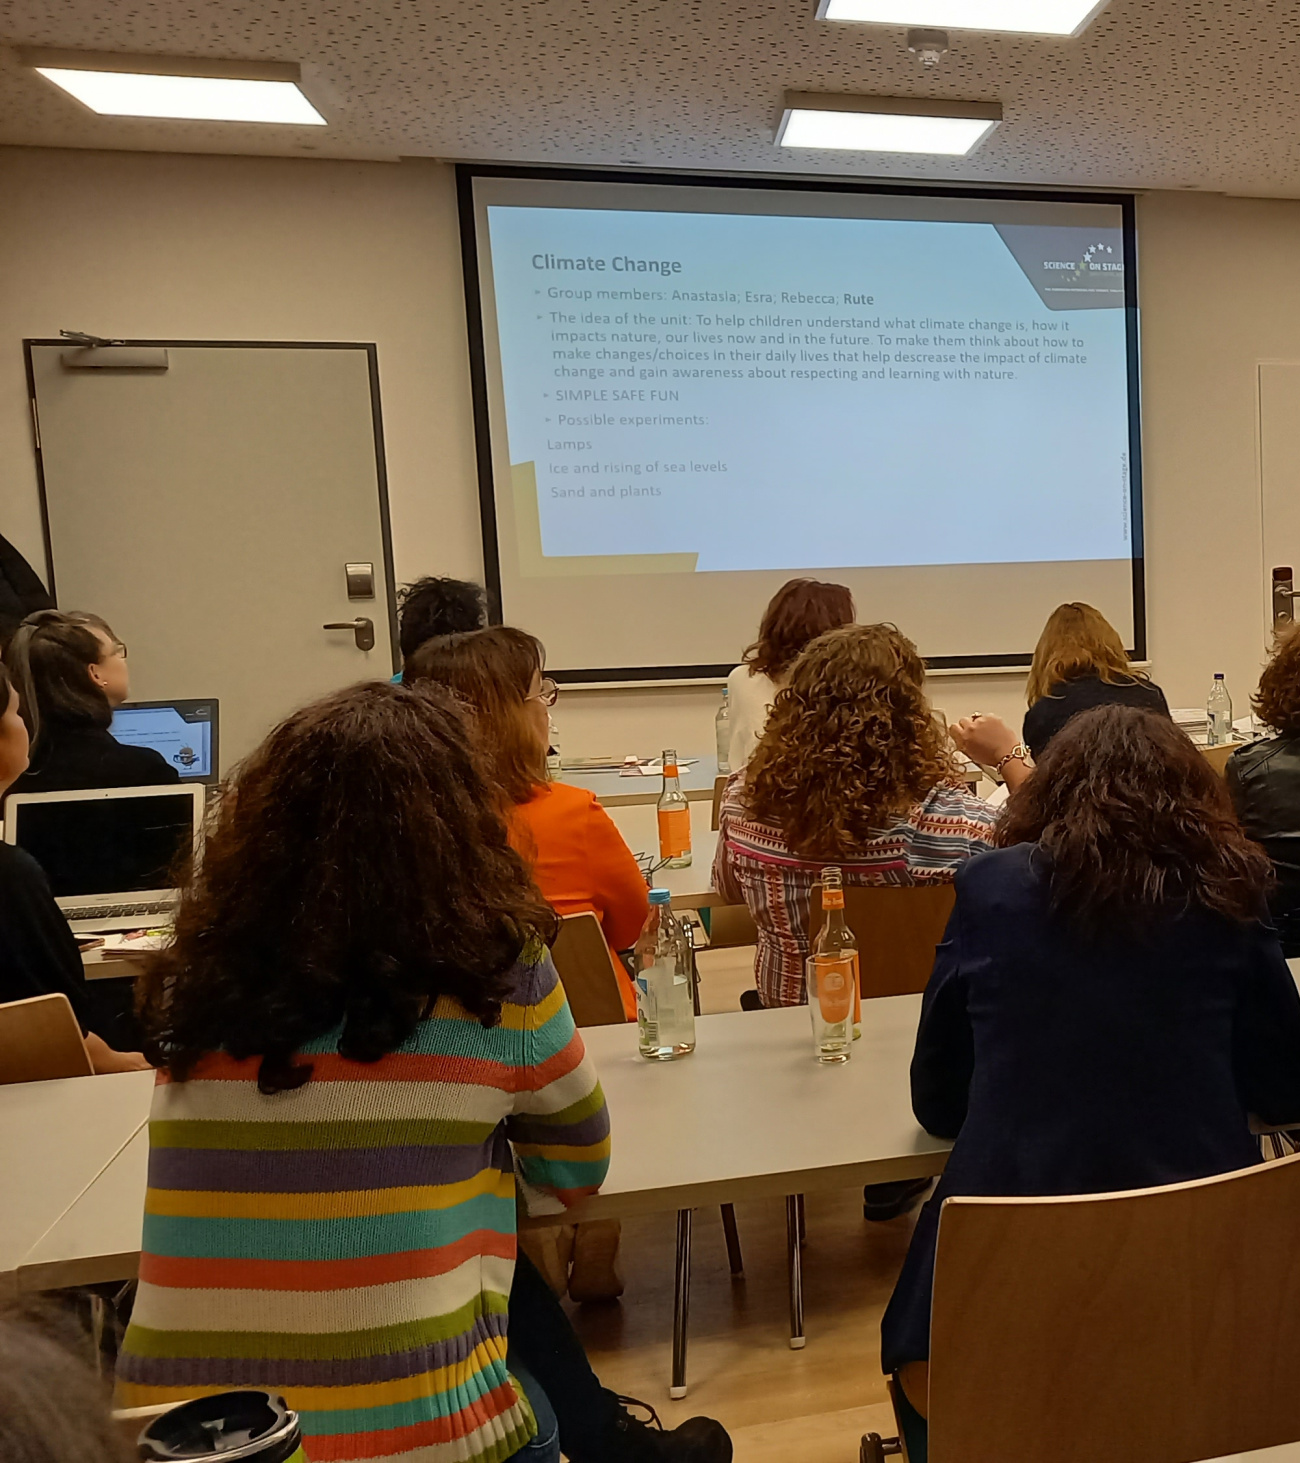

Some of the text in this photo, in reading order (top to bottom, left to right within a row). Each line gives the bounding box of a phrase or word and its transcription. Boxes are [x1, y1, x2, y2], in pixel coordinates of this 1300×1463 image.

[532, 255, 682, 275] Climate Change
[548, 287, 874, 305] Group members: Anastasia; Esra; Rebecca; Rute
[550, 312, 1069, 332] The idea of the unit: To help children understand what climate change is, how it
[552, 330, 1083, 347] impacts nature, our lives now and in the future. To make them think about how to
[553, 348, 1087, 365] make changes/choices in their daily lives that help descrease the impact of climate
[555, 366, 1017, 381] change and gain awareness about respecting and learning with nature.
[556, 390, 679, 401] SIMPLE SAFE FUN
[559, 414, 709, 427] Possible experiments:
[547, 440, 592, 450] Lamps
[550, 461, 727, 475] Ice and rising of sea levels
[552, 485, 661, 498] Sand and plants
